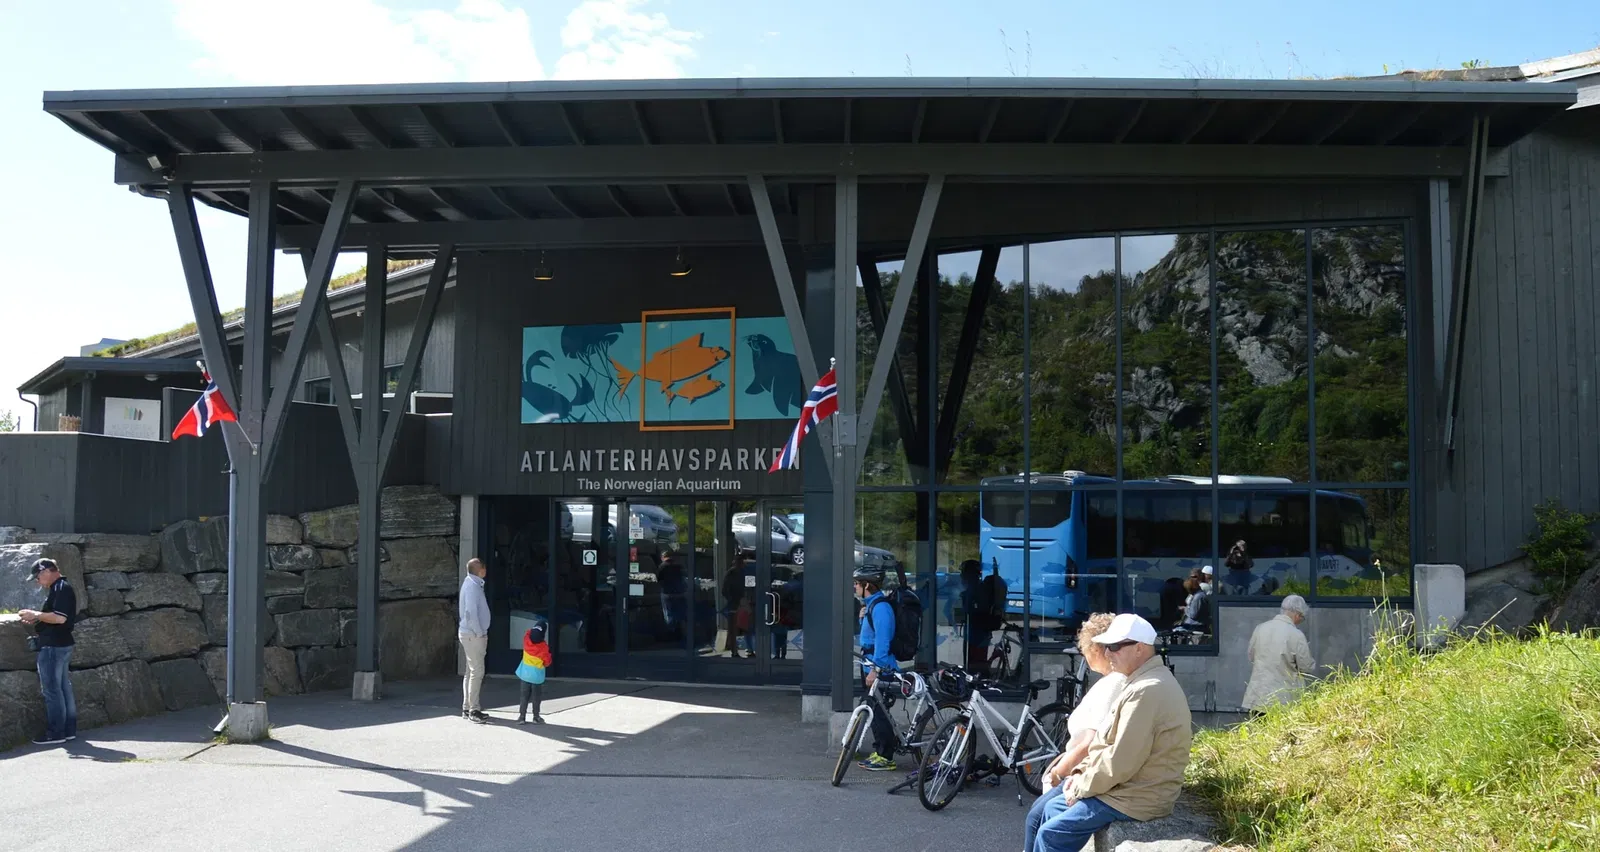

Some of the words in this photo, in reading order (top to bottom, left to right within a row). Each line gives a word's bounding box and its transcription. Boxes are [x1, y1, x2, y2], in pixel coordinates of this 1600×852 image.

[577, 478, 601, 490] The
[604, 478, 673, 493] Norwegian
[675, 477, 741, 491] Aquarium
